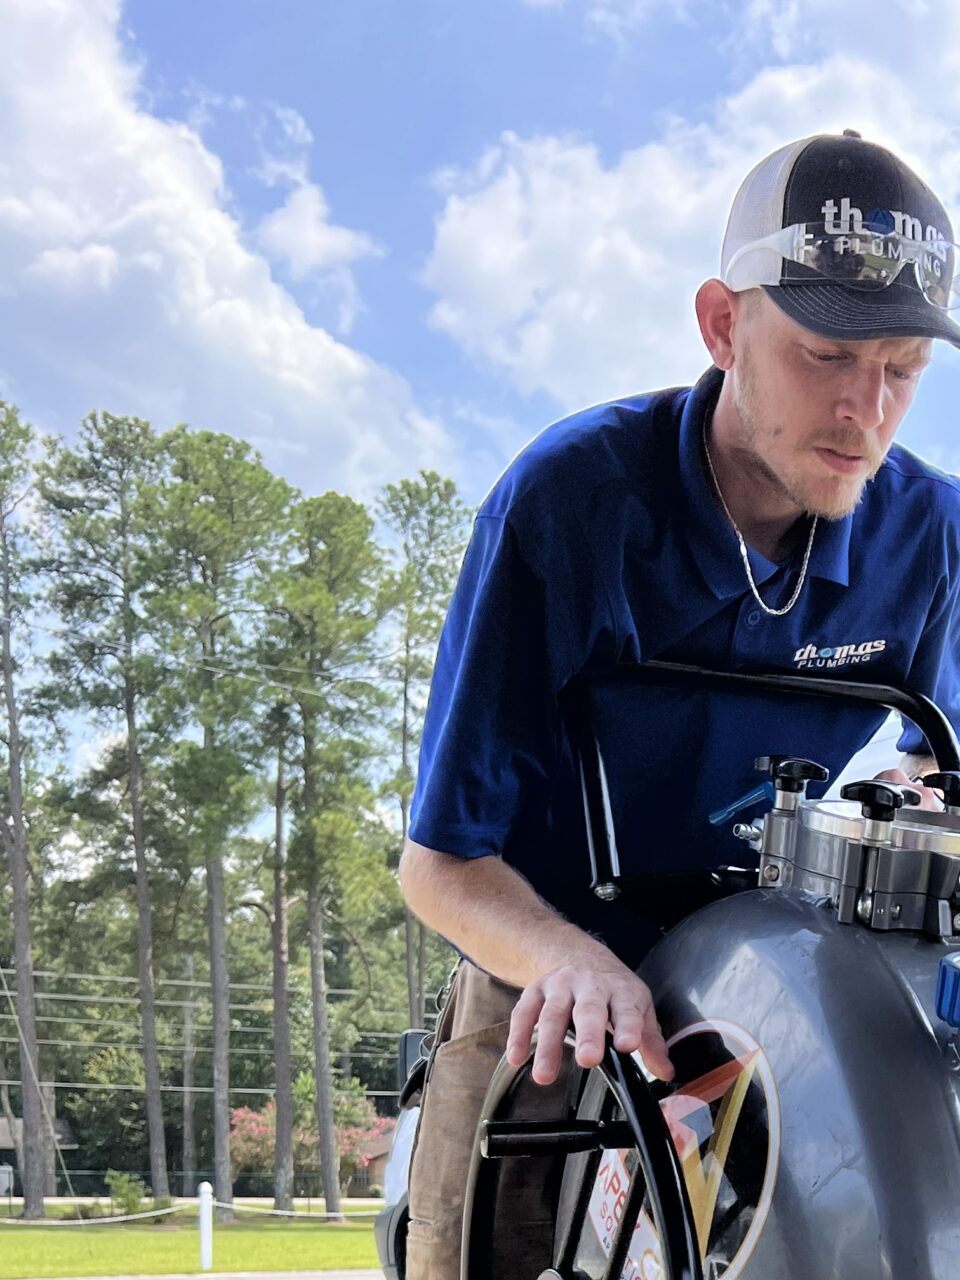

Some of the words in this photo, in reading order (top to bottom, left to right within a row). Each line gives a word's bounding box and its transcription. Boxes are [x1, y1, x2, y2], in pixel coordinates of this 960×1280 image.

[839, 236, 942, 278] PLUMNG
[793, 640, 886, 661] thomas
[797, 654, 871, 669] PLUMBING
